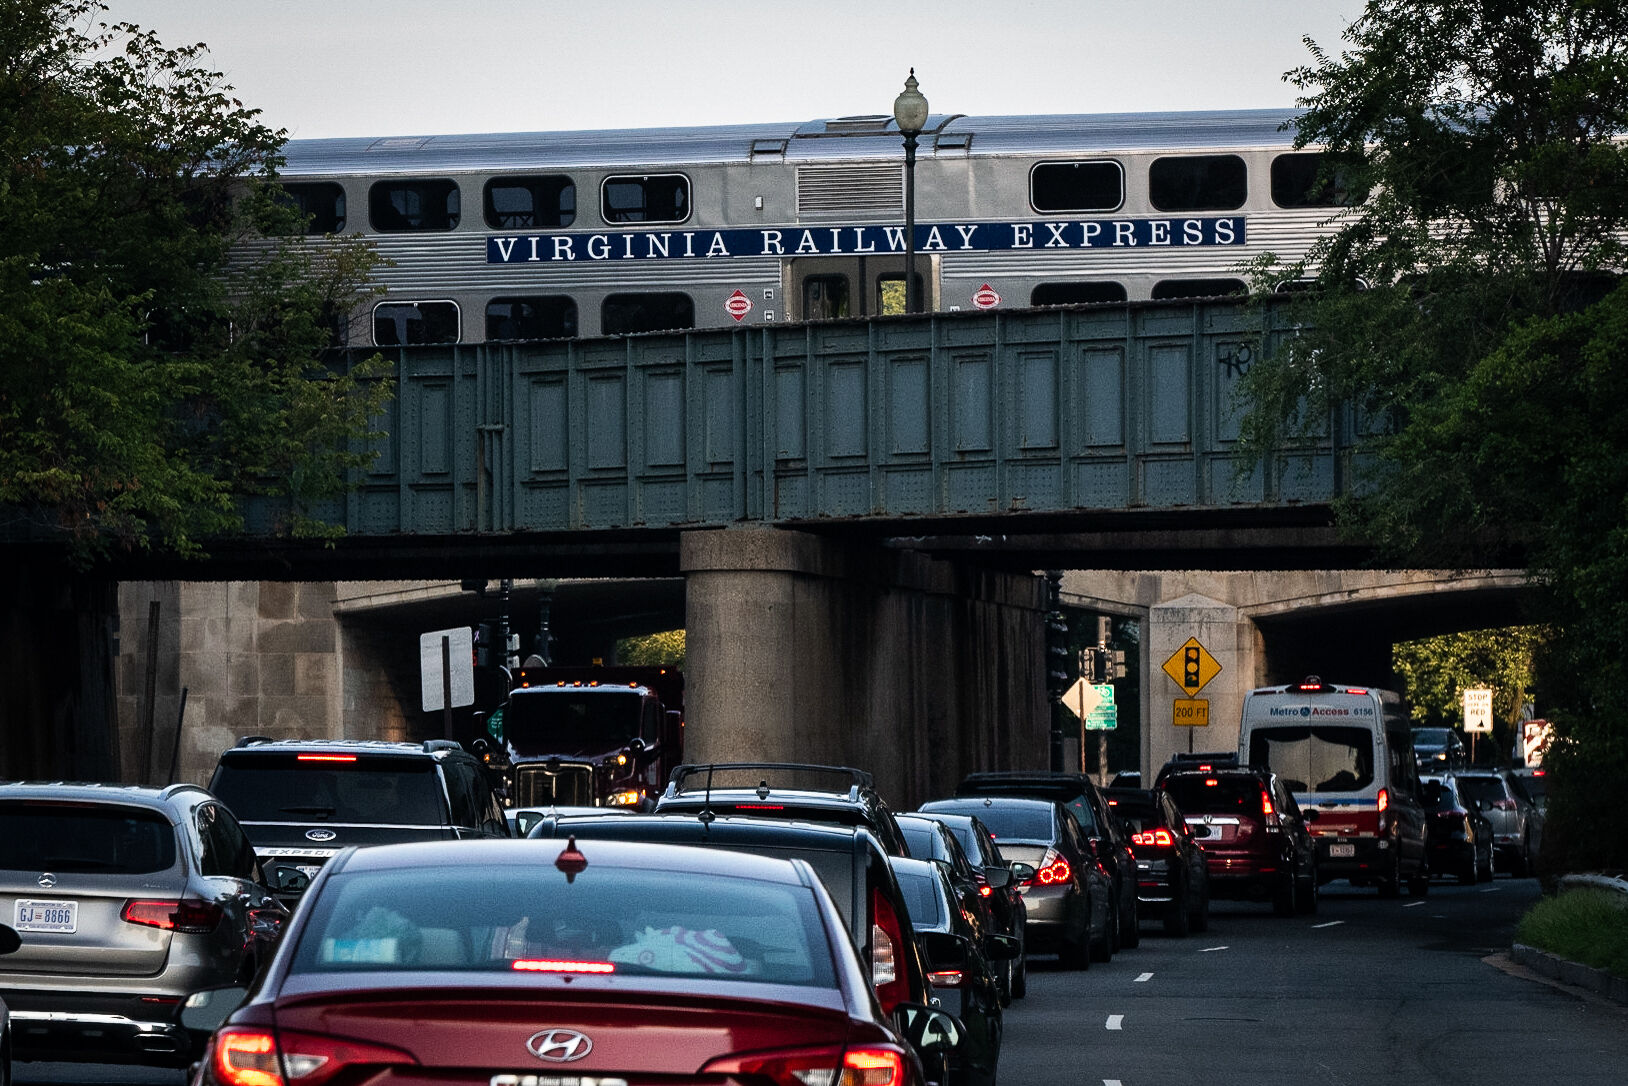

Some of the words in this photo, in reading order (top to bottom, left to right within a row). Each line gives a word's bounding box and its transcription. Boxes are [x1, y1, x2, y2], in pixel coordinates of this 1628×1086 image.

[493, 231, 730, 262] VIRGINIA
[761, 224, 979, 255] RAILWAY
[1011, 218, 1236, 249] EXPRESS
[1176, 707, 1193, 718] 200
[1196, 707, 1207, 718] FT
[1270, 707, 1299, 716] Metro
[1312, 707, 1349, 716] Access
[20, 908, 34, 922] GJ
[44, 909, 71, 924] 8866
